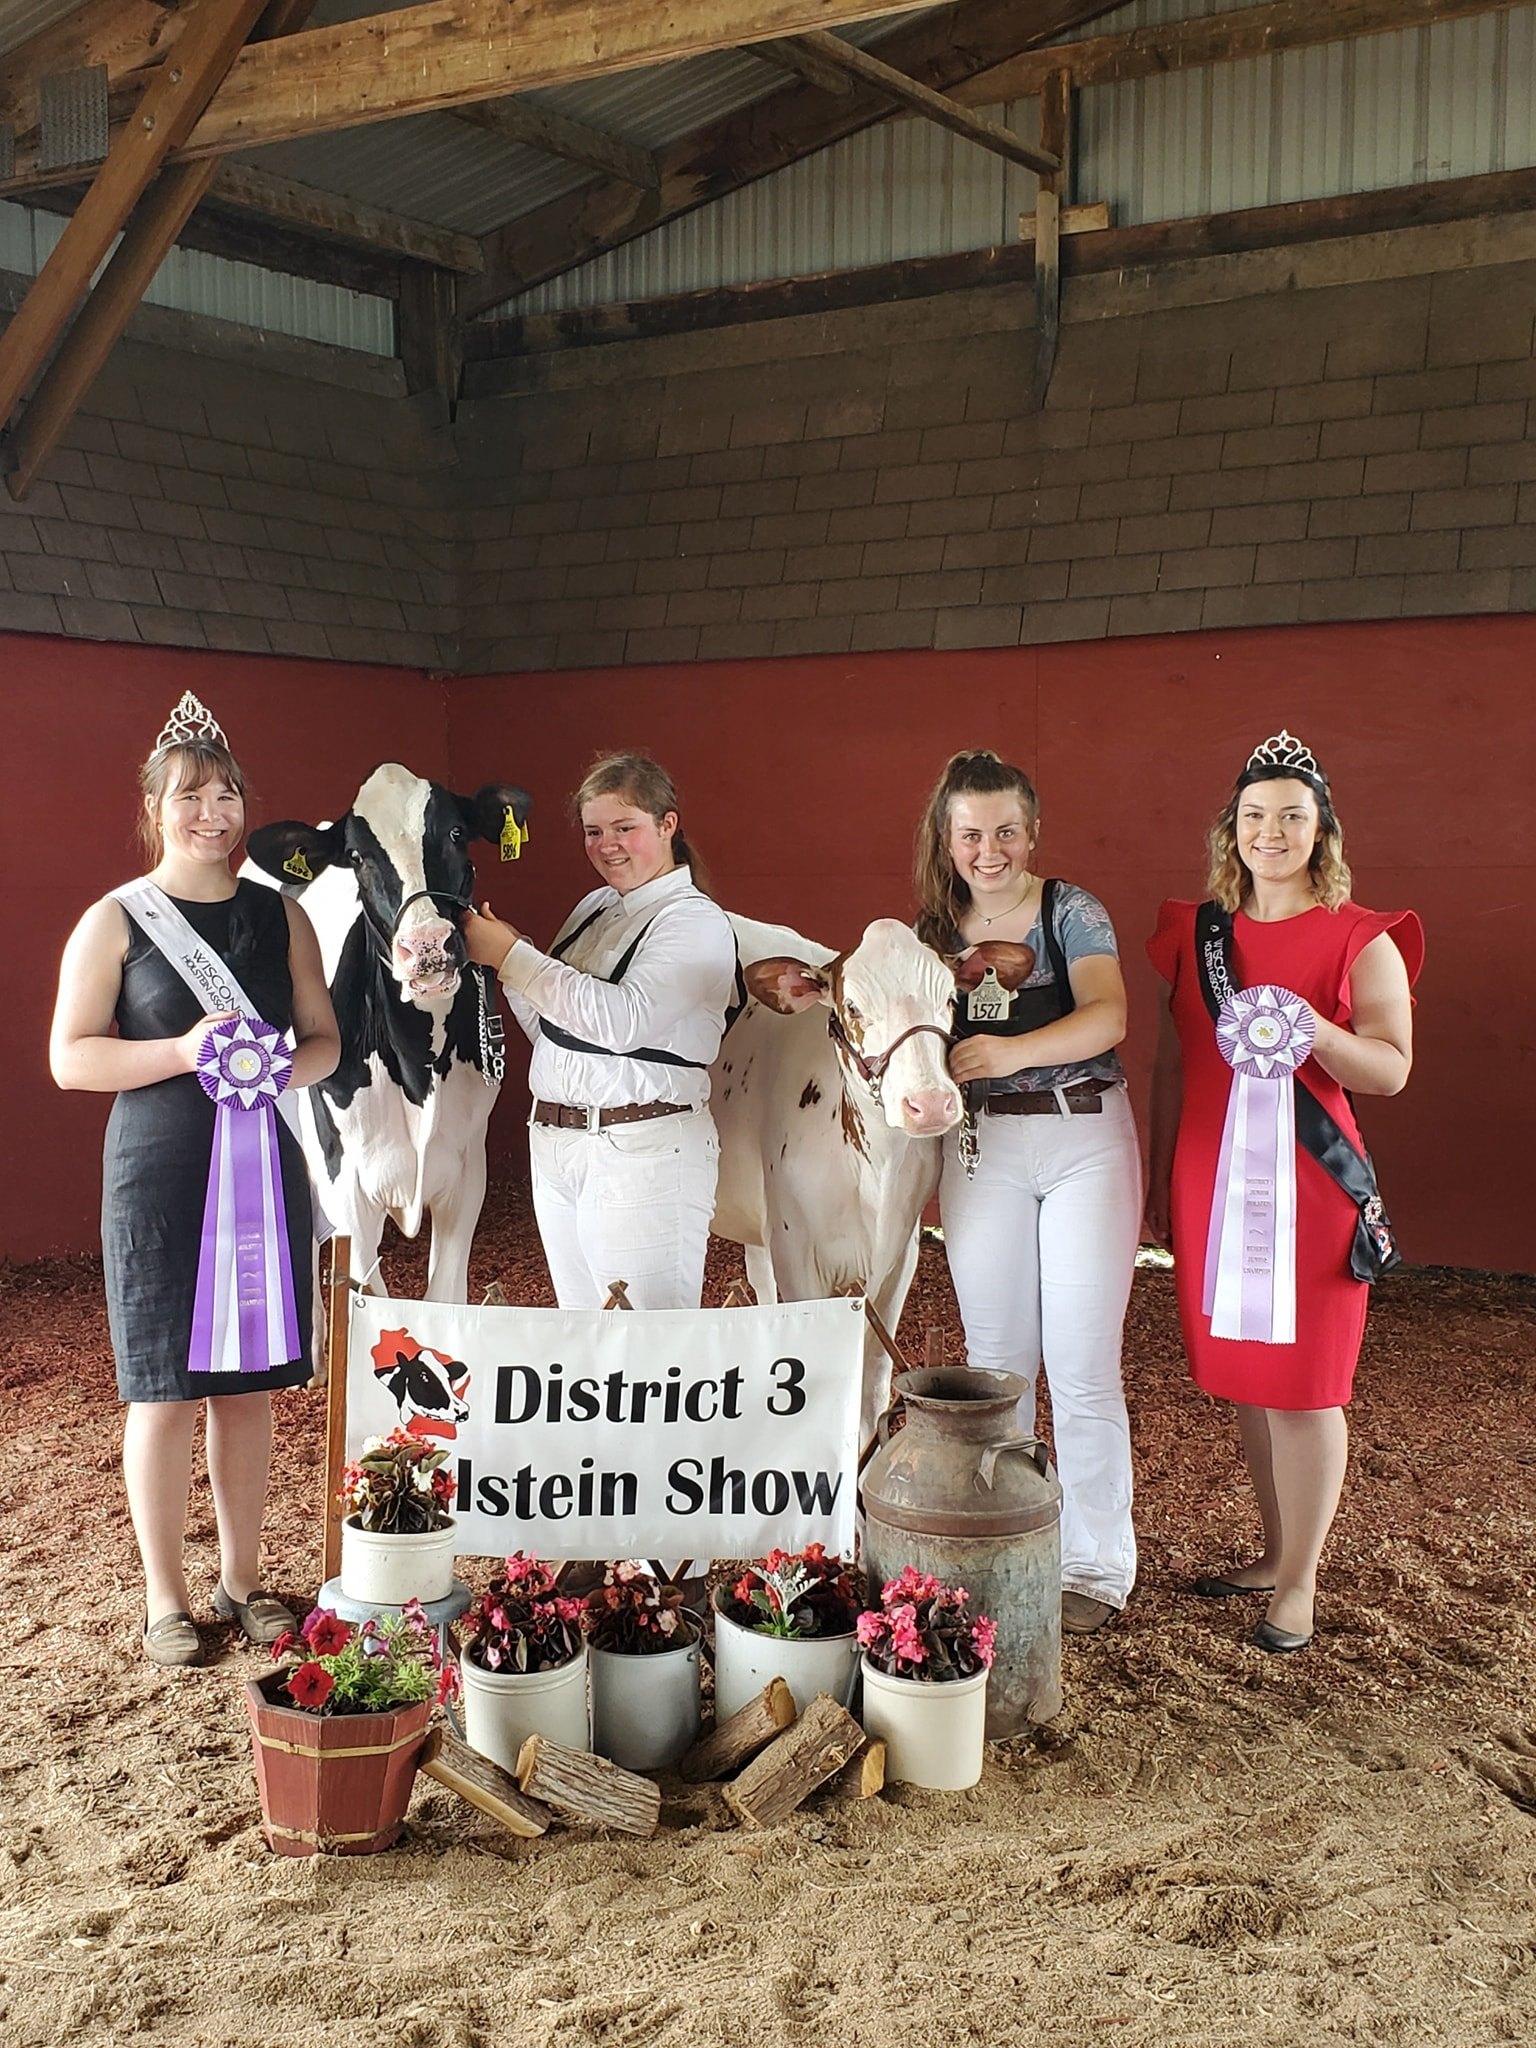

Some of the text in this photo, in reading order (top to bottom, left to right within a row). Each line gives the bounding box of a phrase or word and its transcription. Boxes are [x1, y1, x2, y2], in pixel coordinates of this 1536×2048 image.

[181, 954, 226, 1012] HOLSTEIN ASSO
[193, 949, 247, 1021] WISCONS
[1213, 936, 1235, 1000] WISCONS
[972, 1003, 1002, 1019] 1527
[494, 1357, 806, 1424] District 3
[456, 1455, 843, 1521] lstein Show
